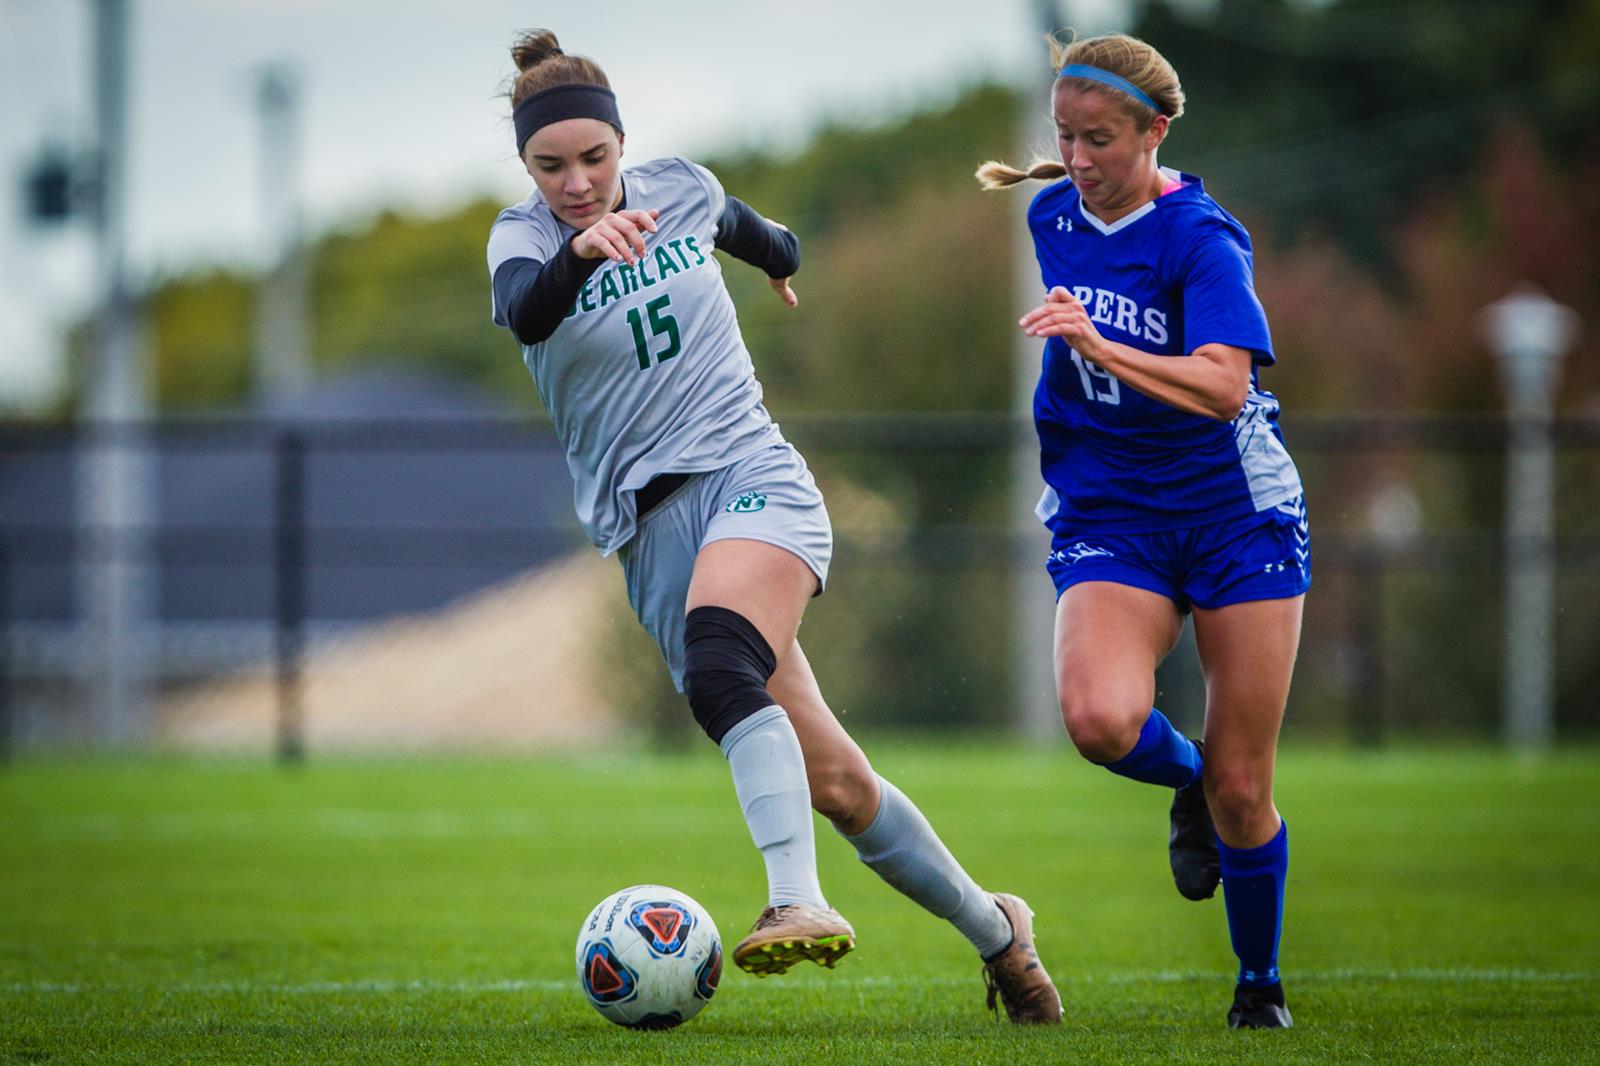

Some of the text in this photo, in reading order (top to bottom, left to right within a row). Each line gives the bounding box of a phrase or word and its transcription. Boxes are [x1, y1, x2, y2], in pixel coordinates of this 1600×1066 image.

[564, 235, 706, 318] EARCATS
[1072, 285, 1169, 345] PERS
[626, 292, 682, 371] 15
